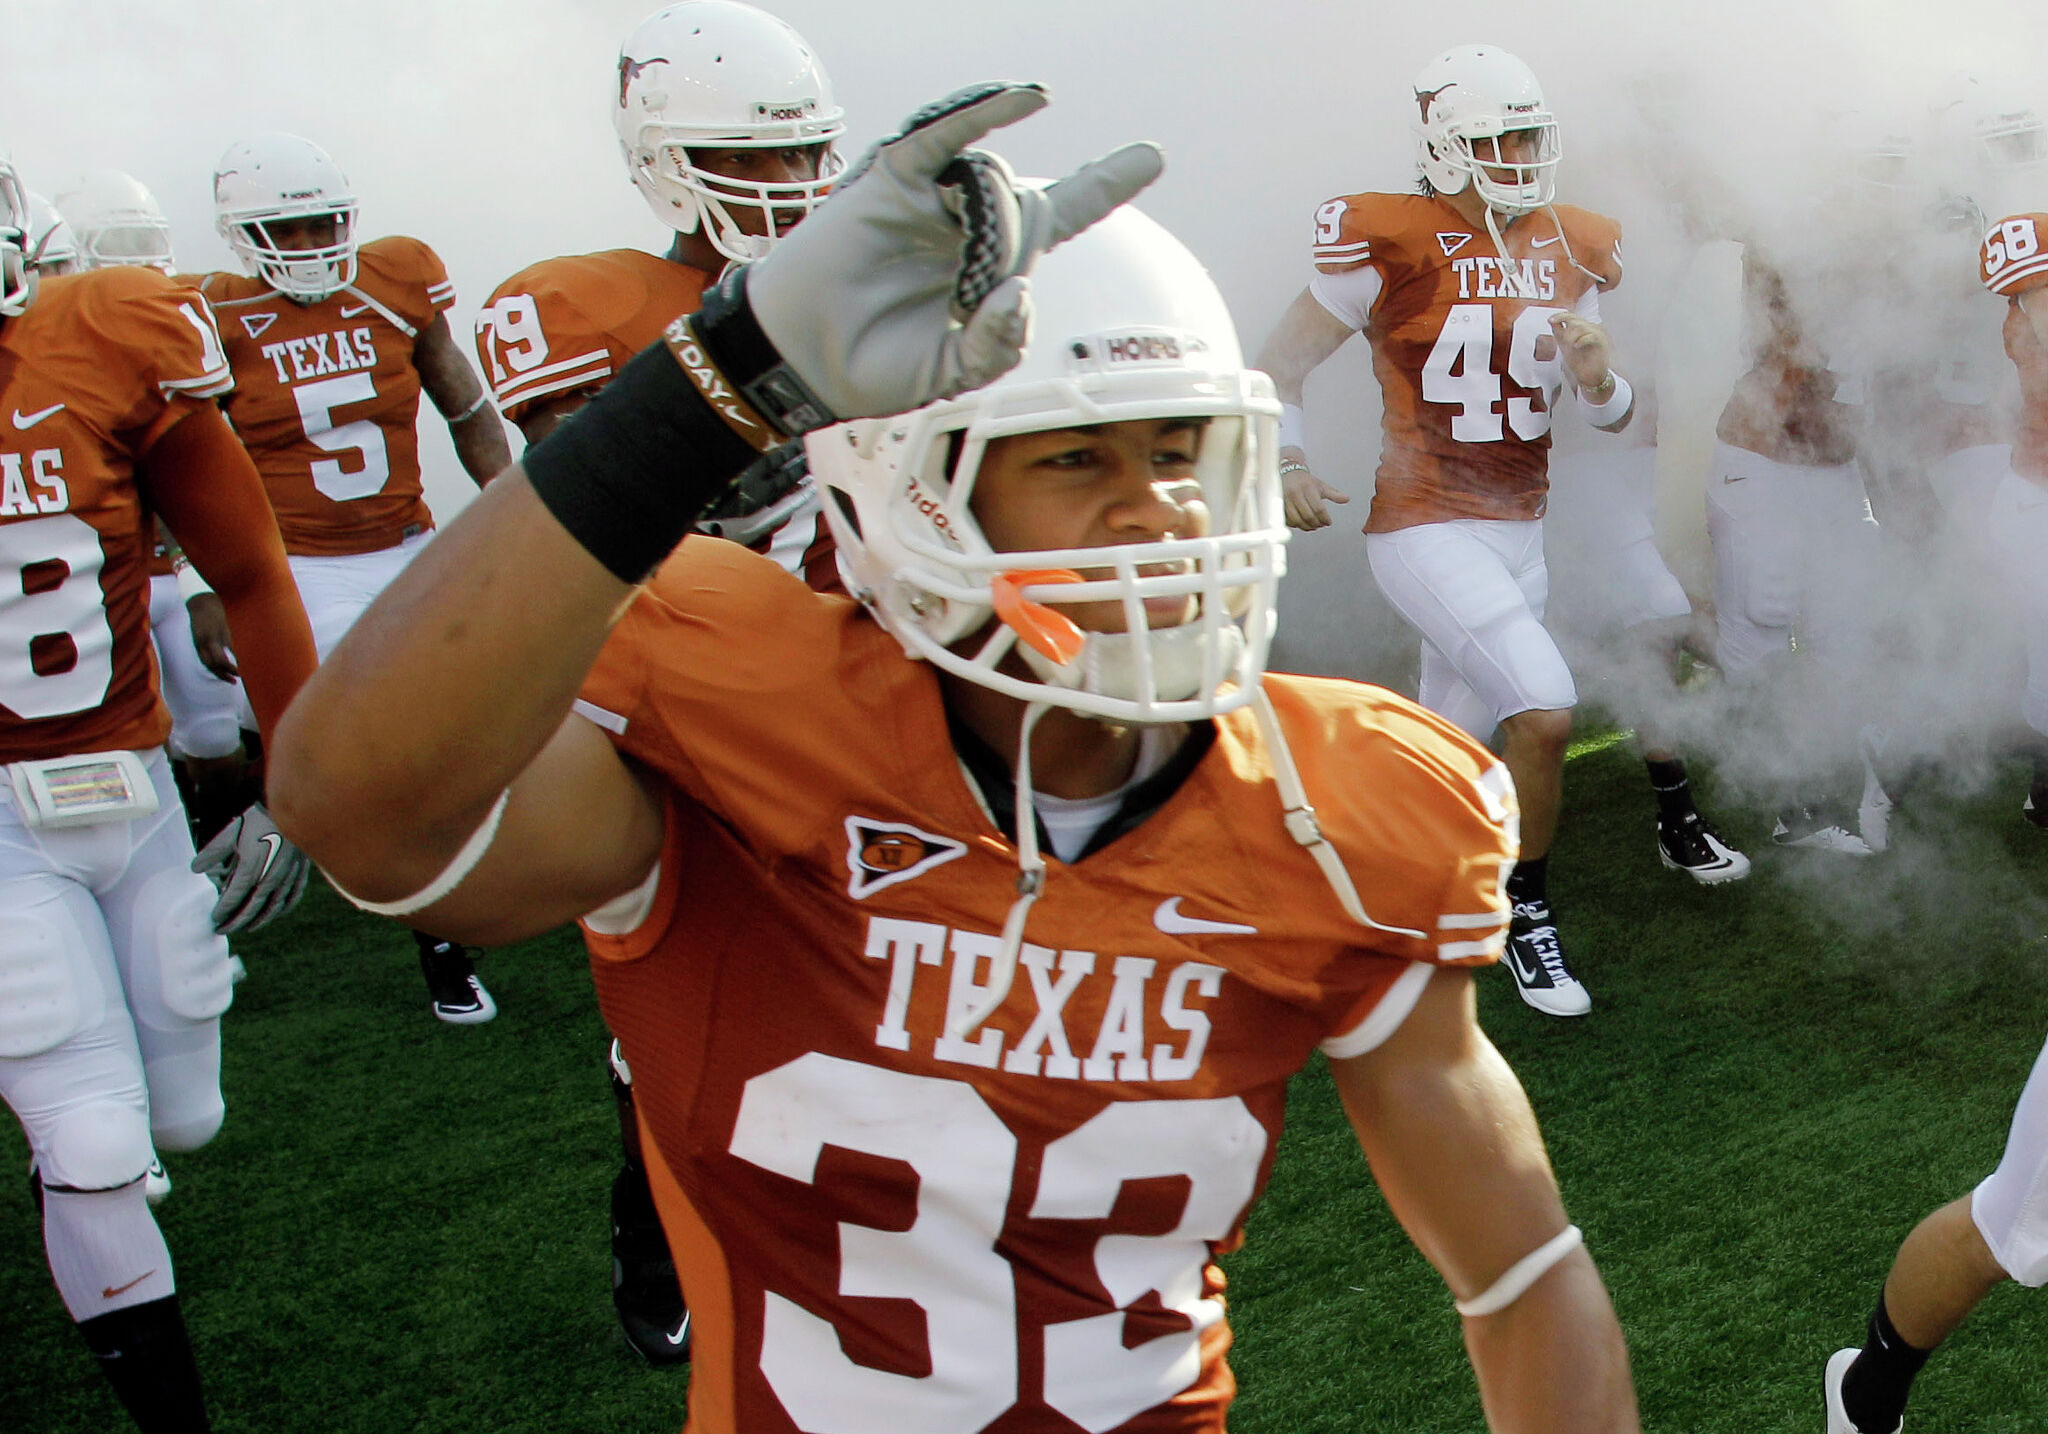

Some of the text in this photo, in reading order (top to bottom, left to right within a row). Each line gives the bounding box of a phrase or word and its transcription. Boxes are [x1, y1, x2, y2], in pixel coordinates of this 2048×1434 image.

[1451, 257, 1556, 300] TEXAS
[1984, 218, 2039, 276] 58
[261, 327, 379, 384] TEXAS
[475, 293, 550, 384] 79
[1421, 304, 1569, 443] 49
[291, 371, 390, 502] 5
[865, 916, 1228, 1082] TEXAS
[728, 1050, 1268, 1434] 33
